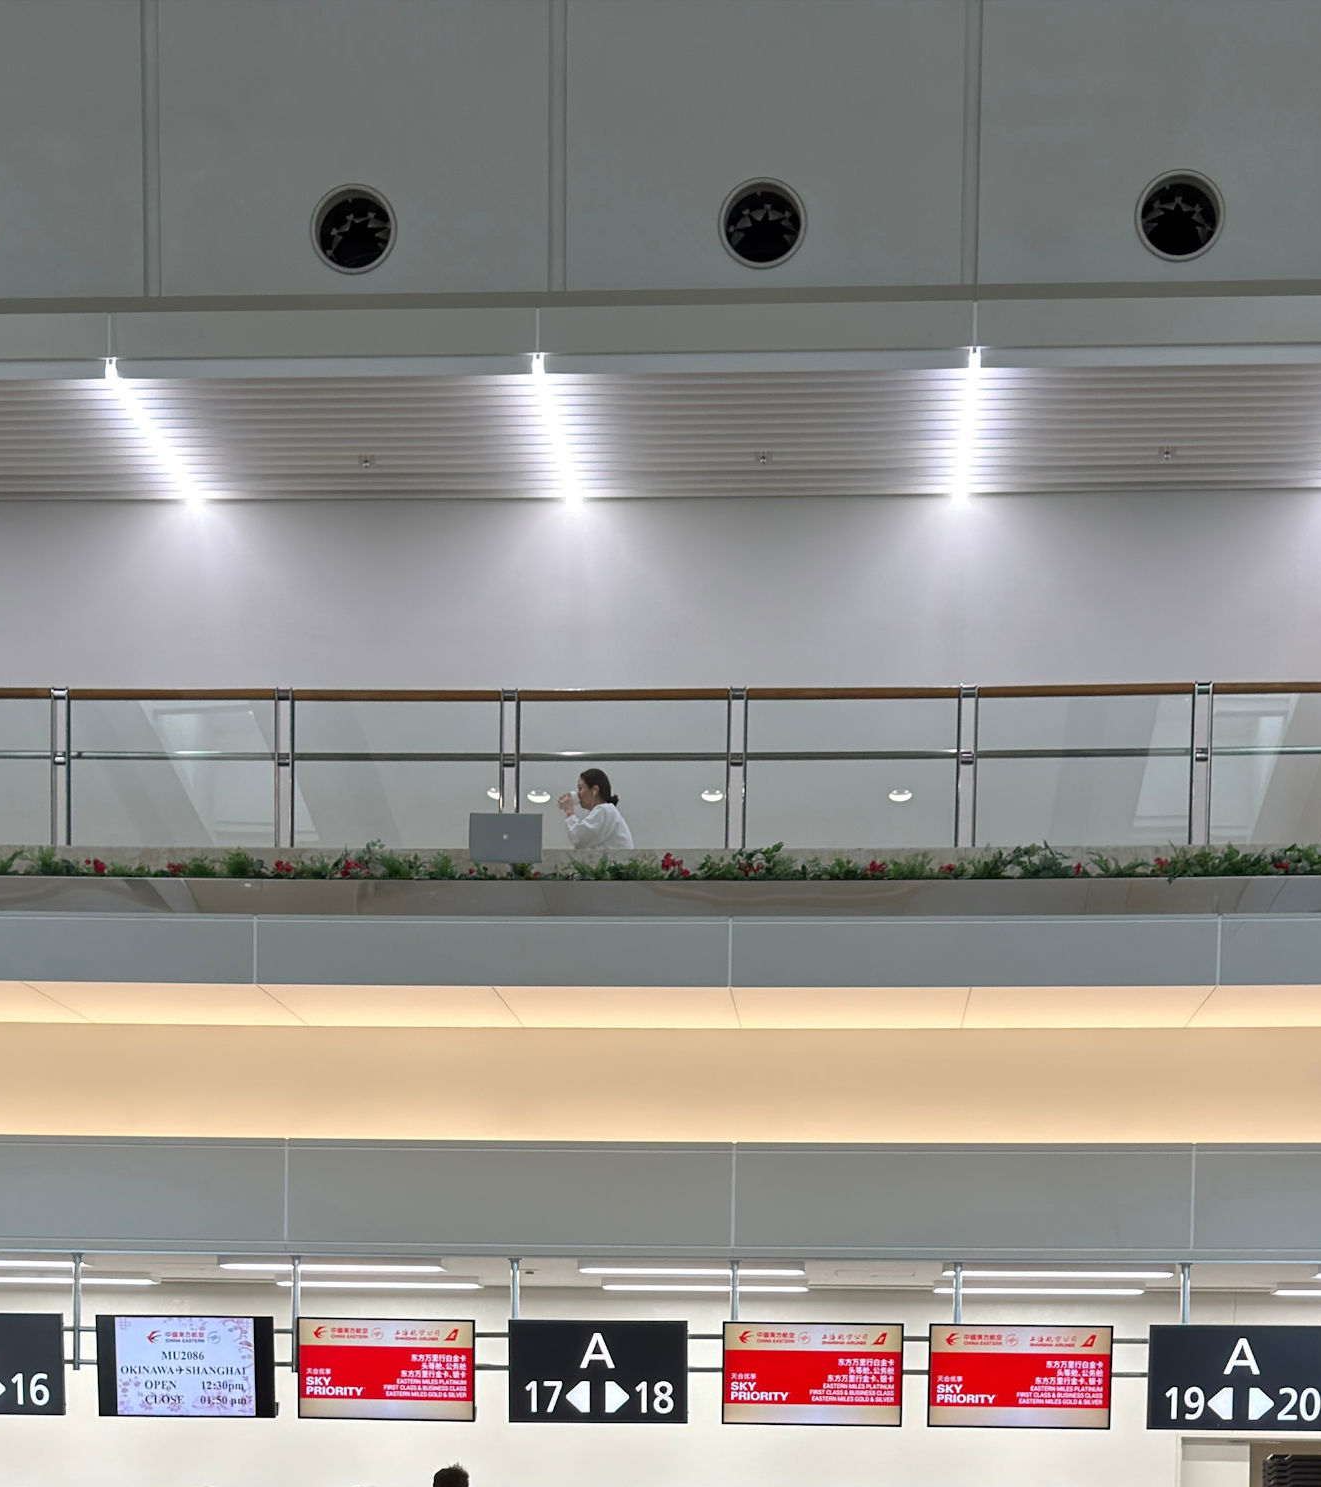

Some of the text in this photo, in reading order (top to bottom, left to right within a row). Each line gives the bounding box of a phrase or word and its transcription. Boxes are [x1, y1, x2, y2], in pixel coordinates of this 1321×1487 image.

[162, 1352, 204, 1360] MU2086
[580, 1333, 615, 1369] A
[1224, 1338, 1260, 1375] A
[121, 1366, 246, 1375] OKINAWA SHANGHAI
[145, 1380, 244, 1392] OPEN 12:30pm
[306, 1377, 331, 1385] SKY
[731, 1382, 756, 1390] SKY
[11, 1373, 49, 1406] 16
[306, 1386, 363, 1396] PRIORITY
[937, 1384, 963, 1393] SKY
[145, 1395, 247, 1407] CLOSE 01:50 pm
[525, 1381, 674, 1414] 17 18
[731, 1392, 789, 1401] PRIORITY
[937, 1394, 995, 1404] PRIORITY
[1165, 1387, 1321, 1421] 19 20
